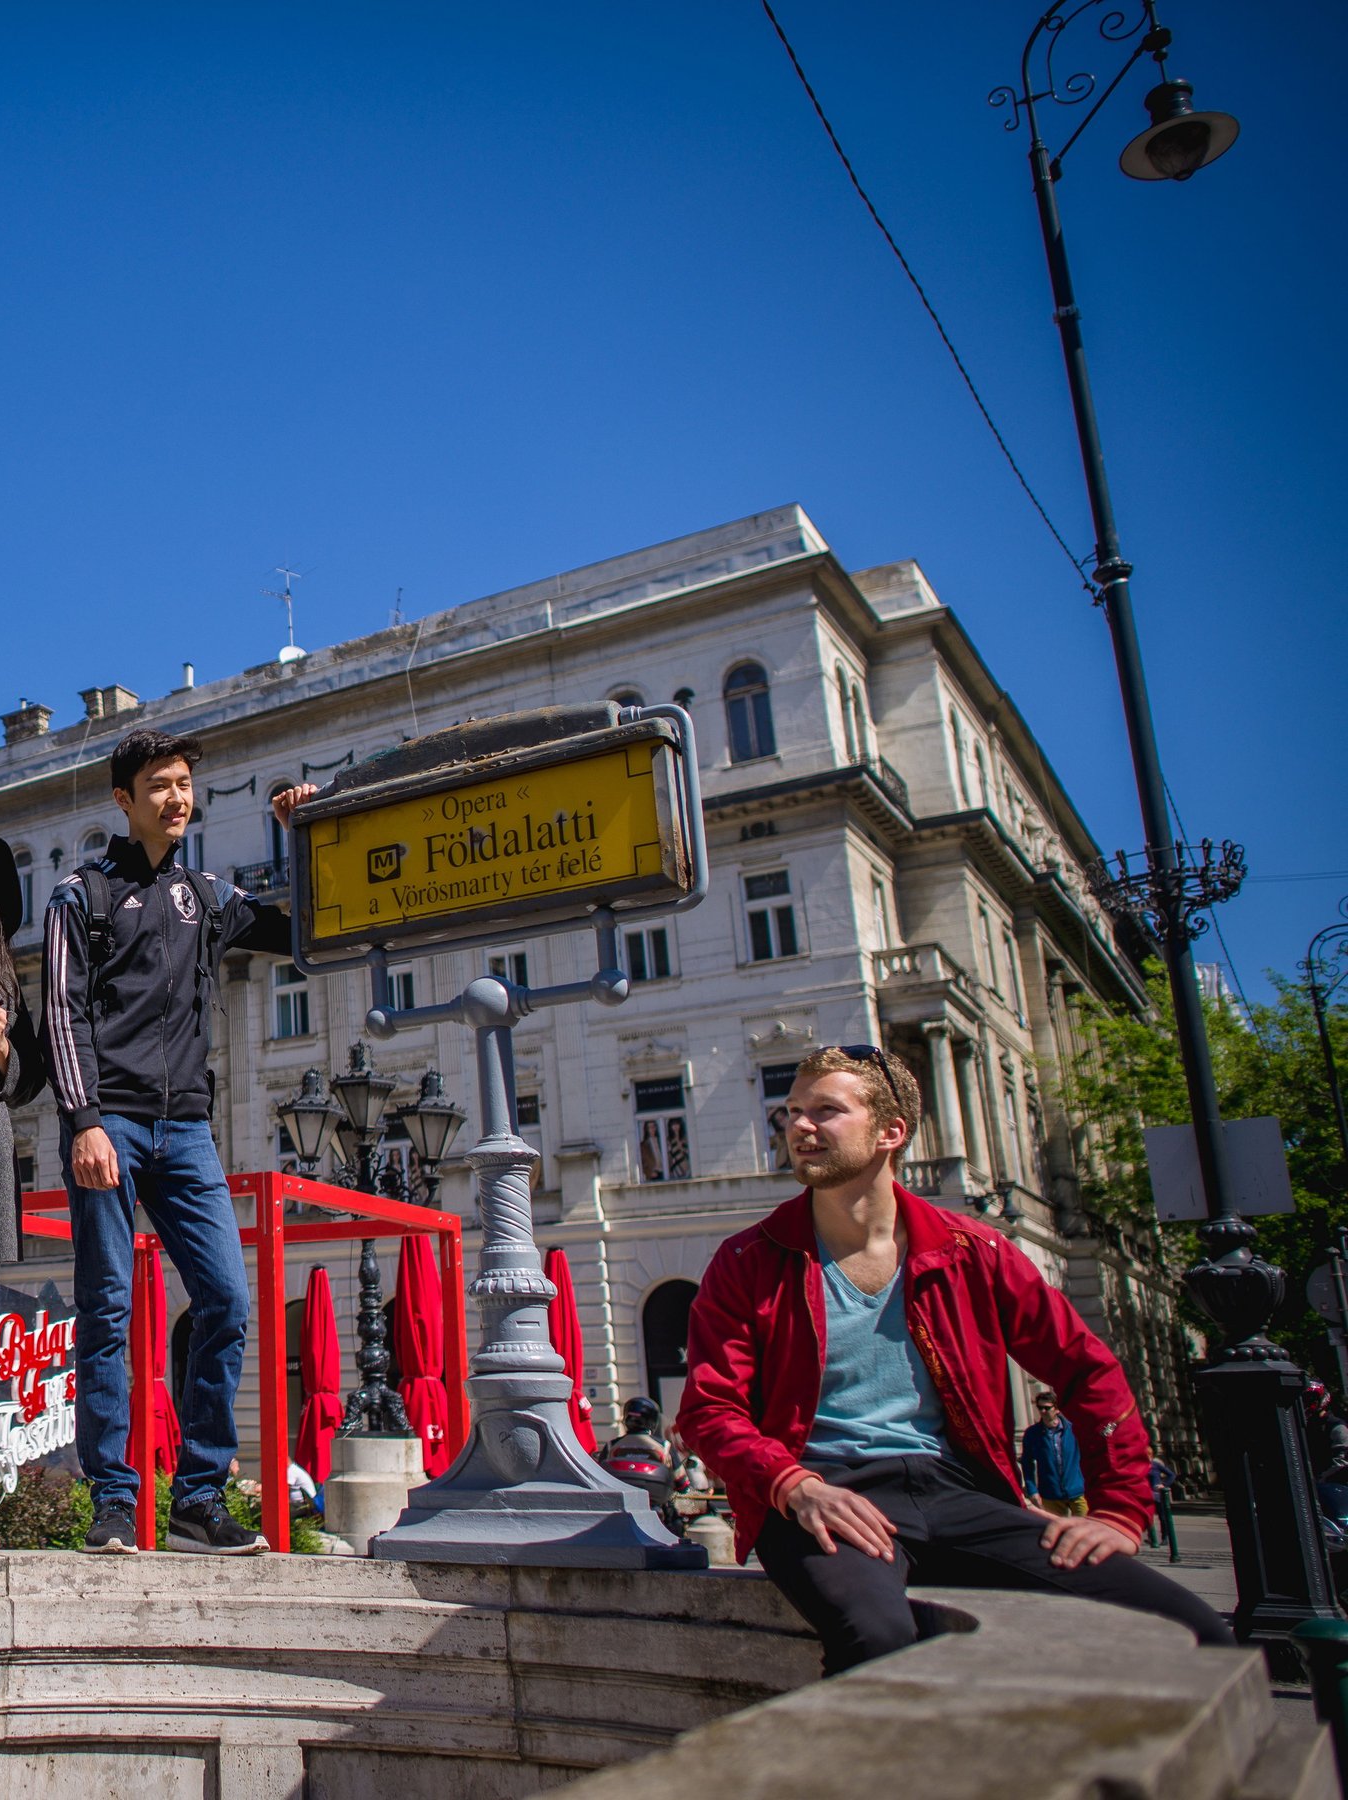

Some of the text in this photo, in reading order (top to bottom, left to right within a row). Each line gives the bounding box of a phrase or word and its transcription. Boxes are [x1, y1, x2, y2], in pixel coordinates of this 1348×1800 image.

[441, 791, 508, 824] Opera
[374, 851, 394, 869] M
[424, 800, 600, 874] Földalatti
[368, 846, 602, 916] a Vörösmarty tér felé
